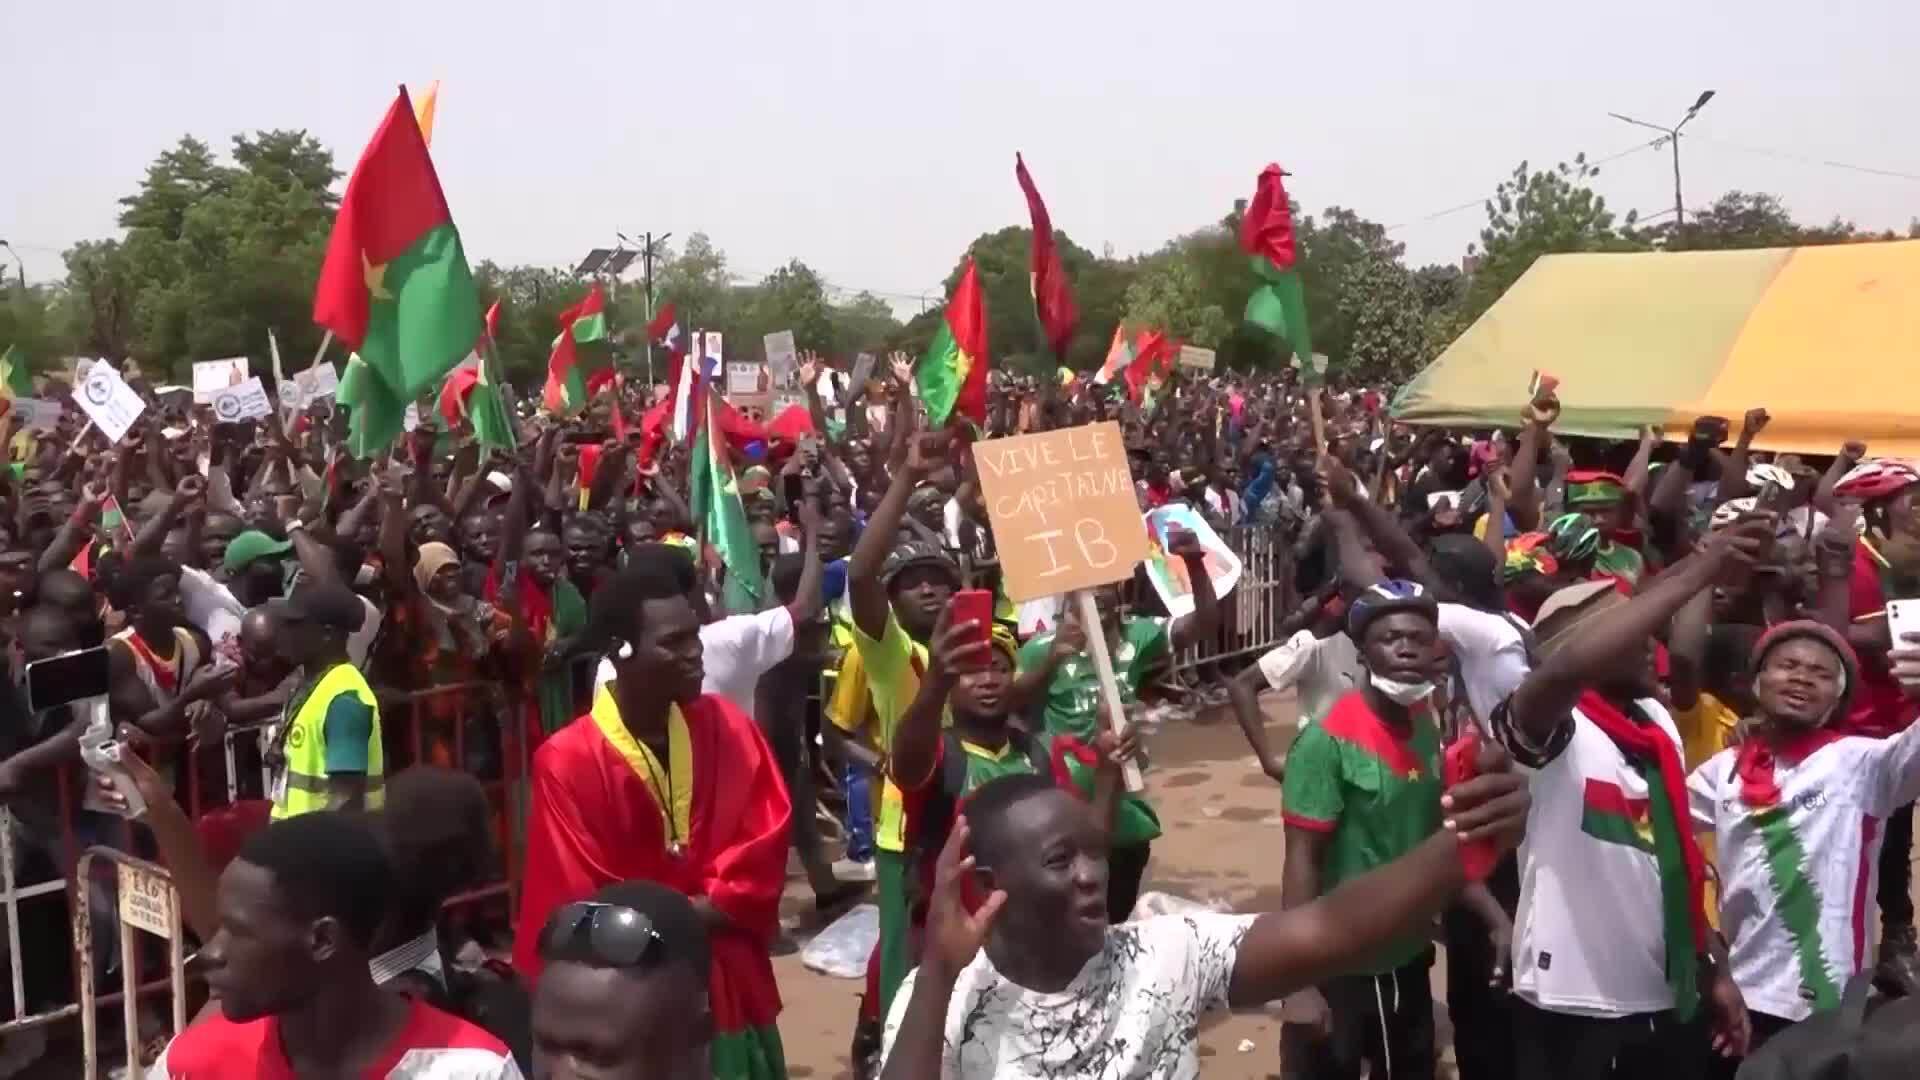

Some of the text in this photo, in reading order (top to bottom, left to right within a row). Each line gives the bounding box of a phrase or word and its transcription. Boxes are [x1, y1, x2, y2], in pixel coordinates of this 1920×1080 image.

[984, 432, 1109, 477] VIVE LE
[996, 469, 1132, 524] CAPITAINE
[1024, 518, 1118, 577] IB
